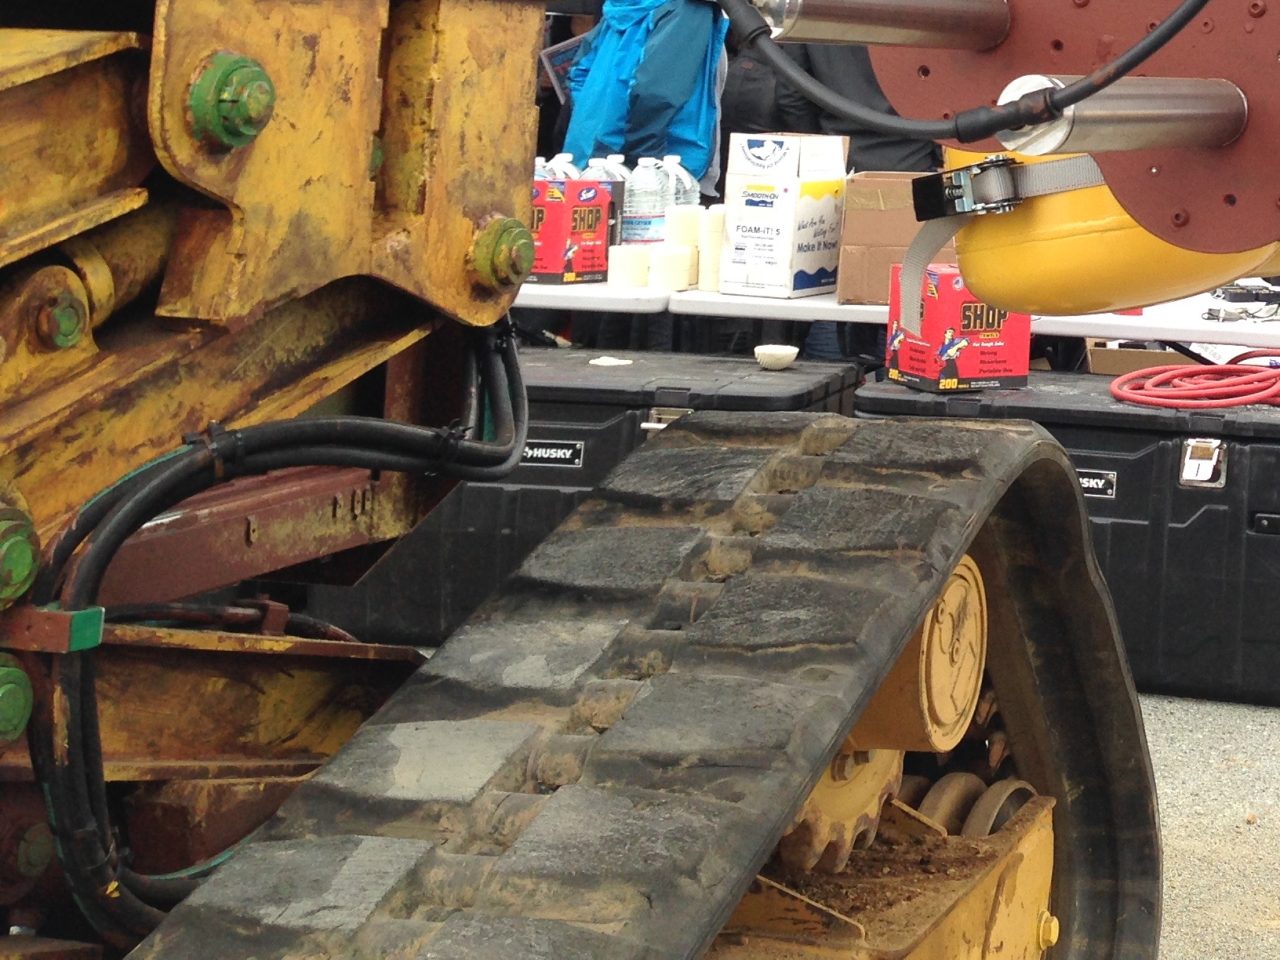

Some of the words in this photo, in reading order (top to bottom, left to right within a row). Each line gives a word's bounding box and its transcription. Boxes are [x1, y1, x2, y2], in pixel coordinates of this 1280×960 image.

[572, 207, 602, 231] SHOP
[939, 378, 958, 389] 200
[533, 448, 573, 459] HUSKY
